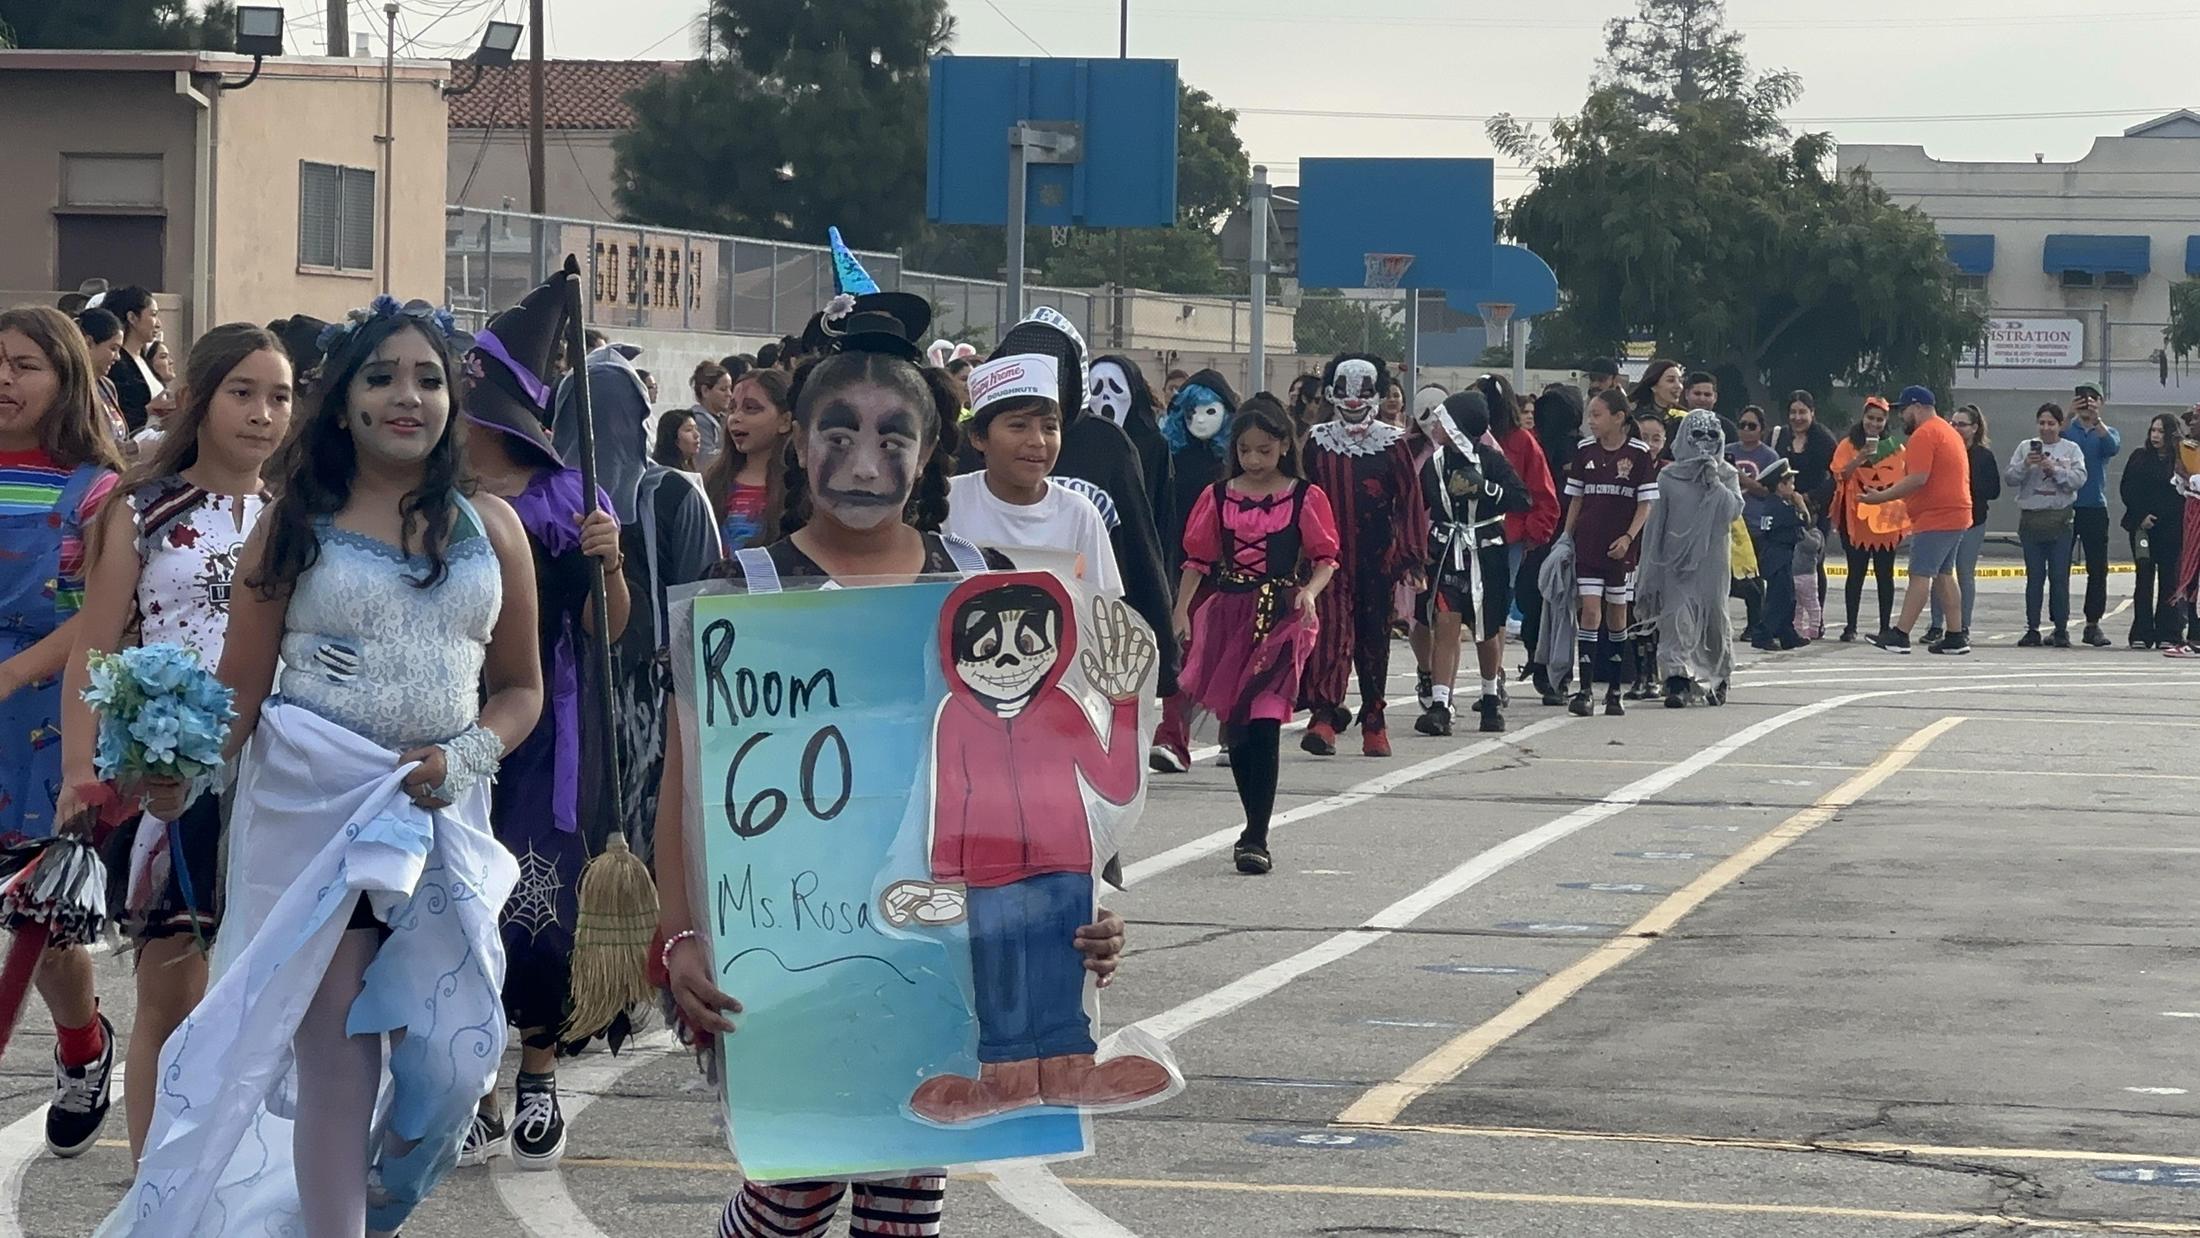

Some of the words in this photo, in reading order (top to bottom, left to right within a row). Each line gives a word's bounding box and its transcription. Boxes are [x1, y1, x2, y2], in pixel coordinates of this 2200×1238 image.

[595, 242, 619, 302] GO
[1991, 331, 2071, 341] ISTRATION
[986, 386, 1039, 401] DOUGHNUTS
[702, 618, 840, 727] Room
[725, 724, 852, 841] 60
[718, 863, 783, 936] Ms.
[791, 870, 884, 936] Rosa
